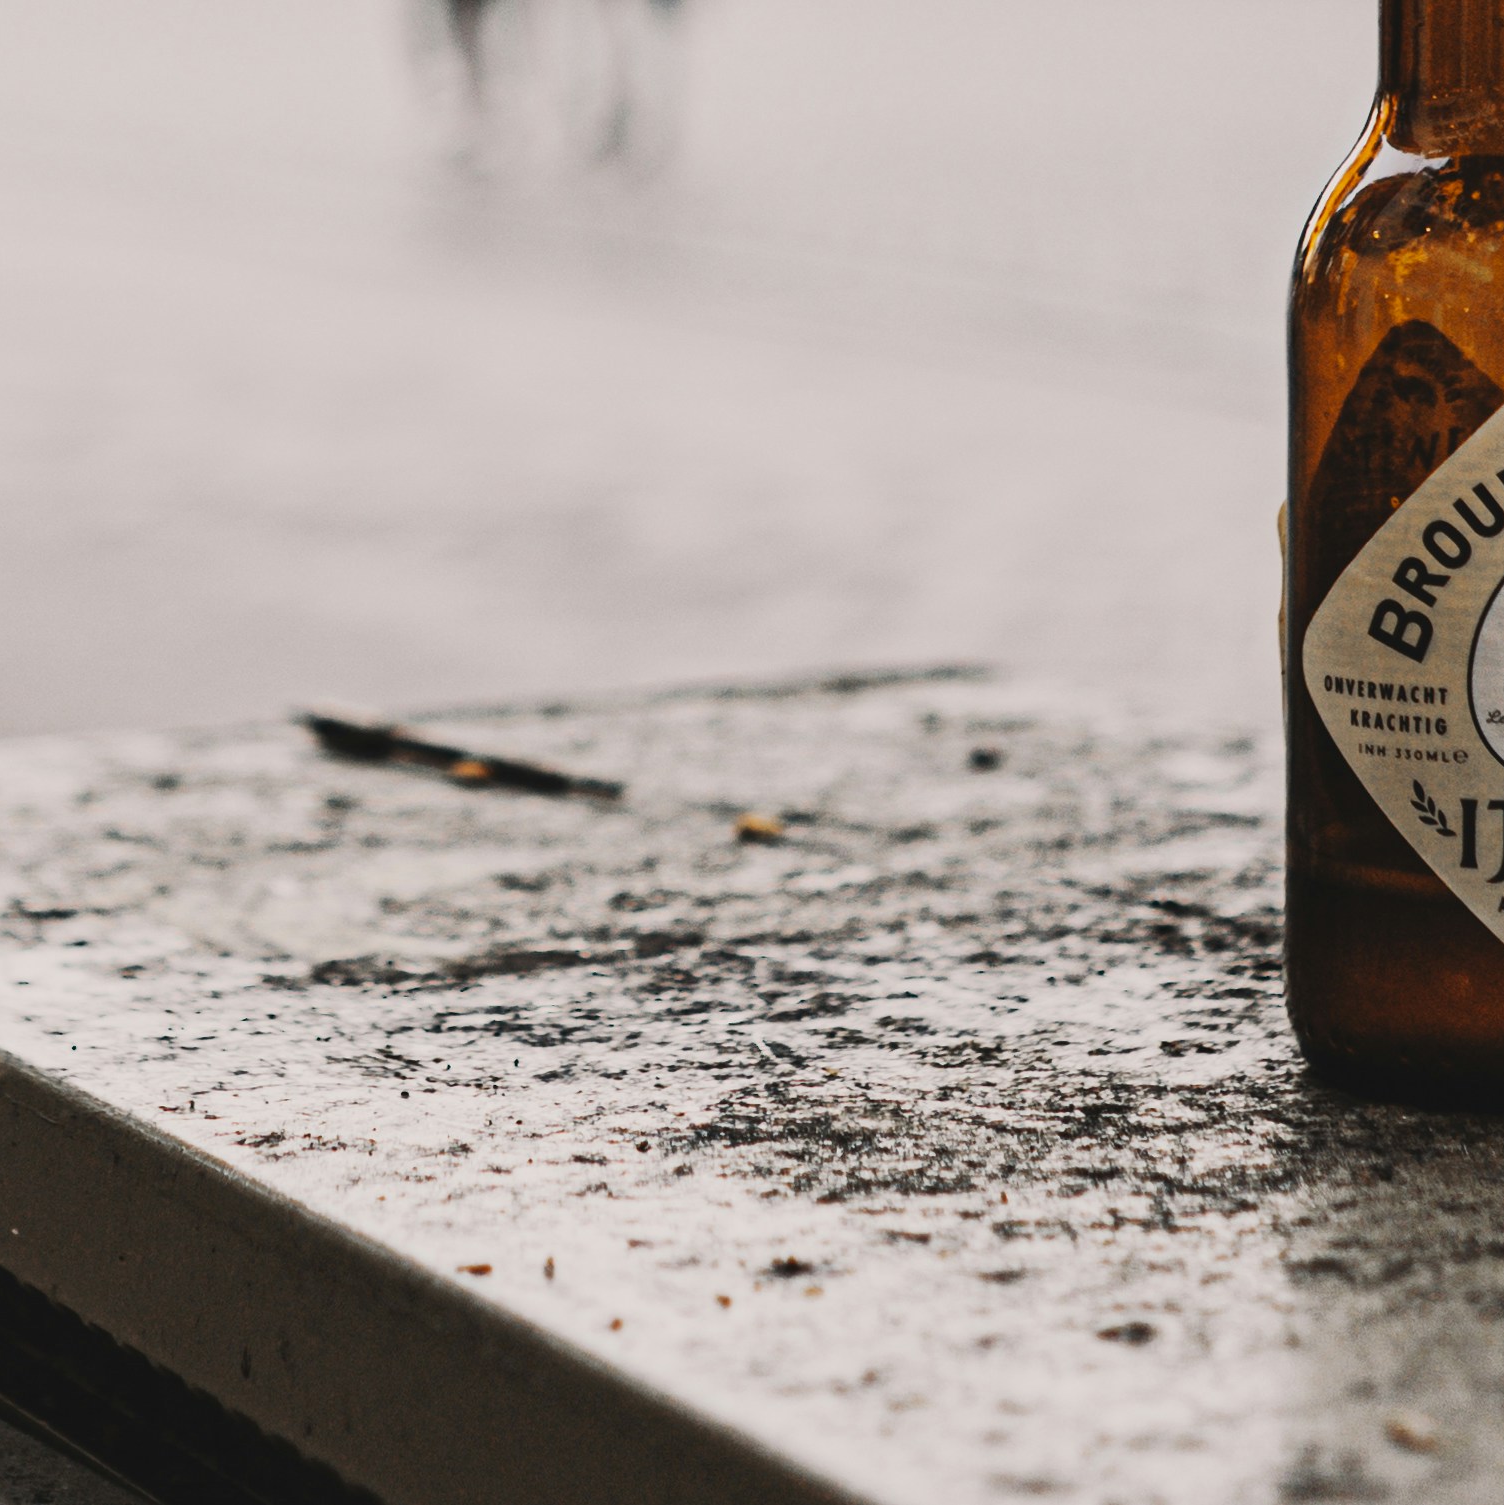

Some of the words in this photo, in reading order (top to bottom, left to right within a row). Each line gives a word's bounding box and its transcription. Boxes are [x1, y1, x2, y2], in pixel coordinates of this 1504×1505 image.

[1323, 674, 1448, 705] ONVERWACHT
[1350, 709, 1448, 736] KRACHTIG
[1358, 743, 1387, 757] INH
